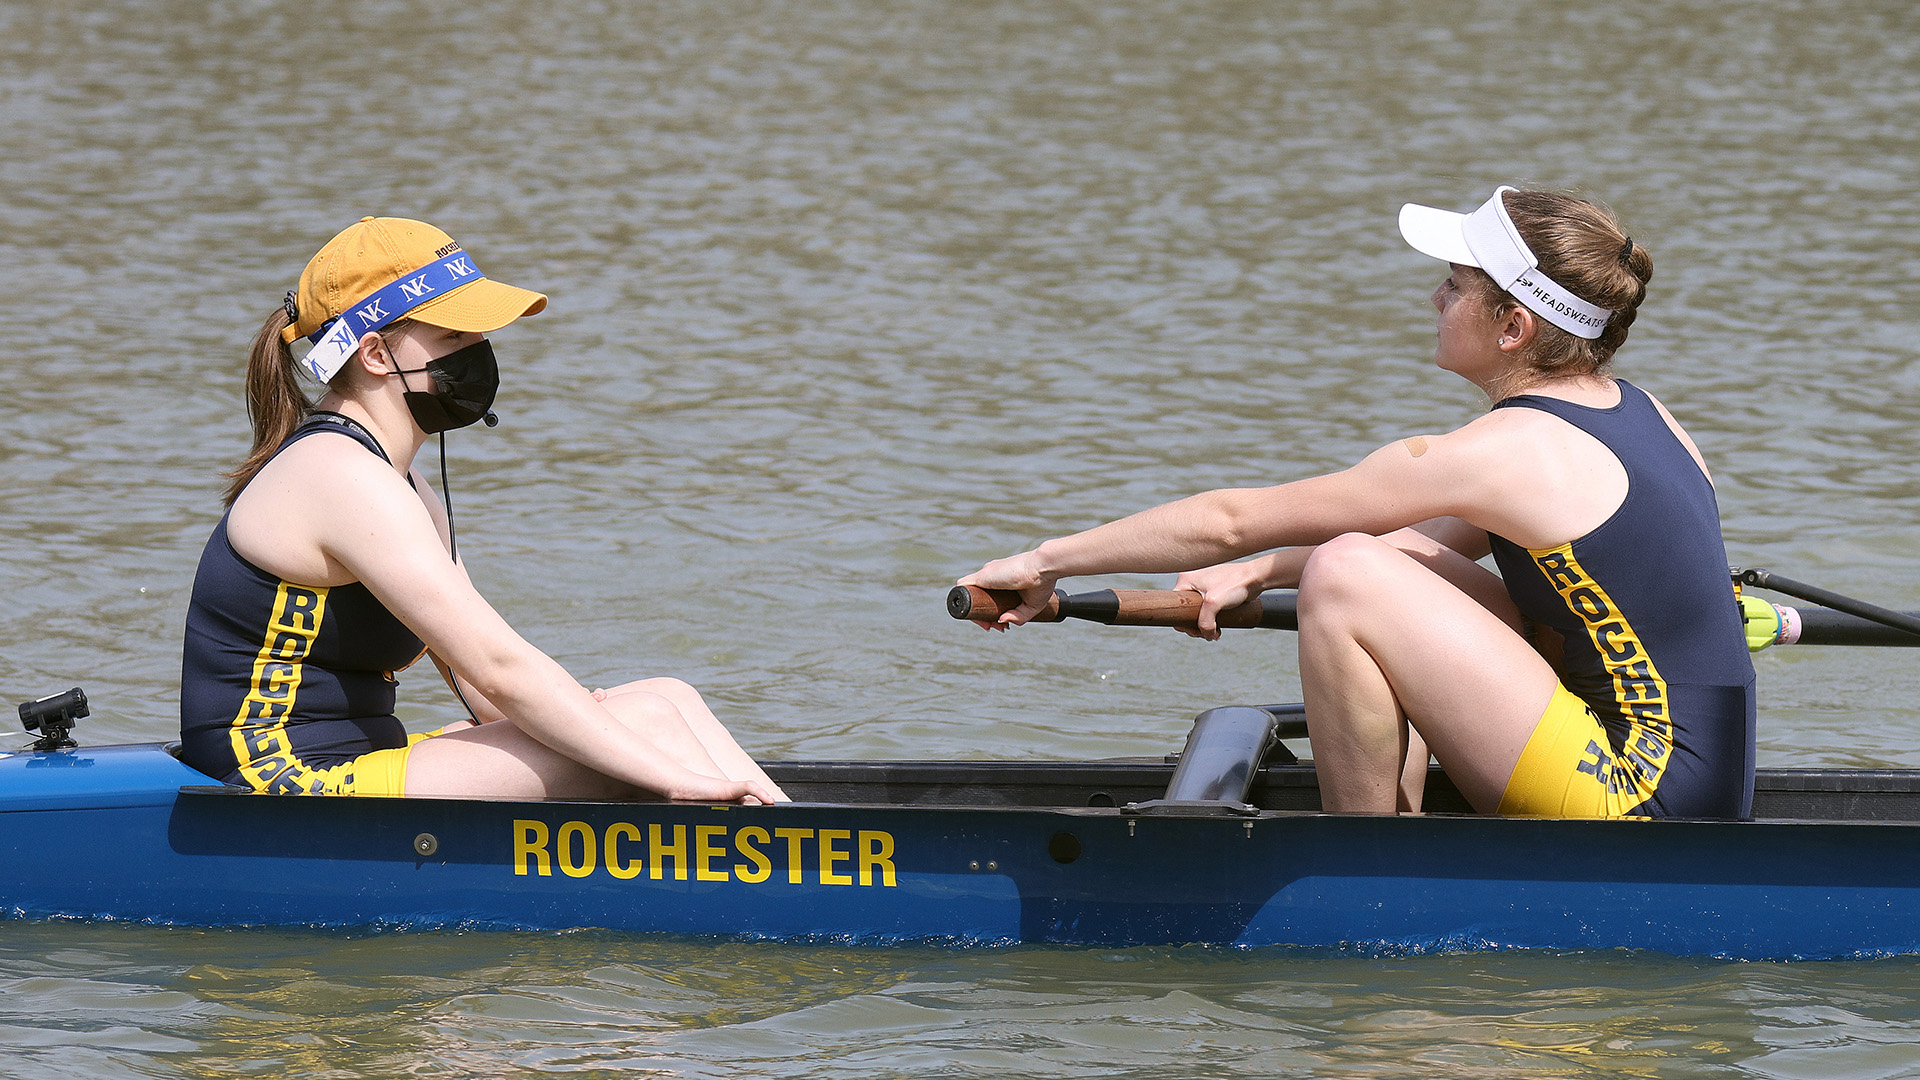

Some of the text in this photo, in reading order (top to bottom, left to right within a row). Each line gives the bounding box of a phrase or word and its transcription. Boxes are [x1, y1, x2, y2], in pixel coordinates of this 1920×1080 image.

[355, 256, 476, 330] NK NK NK
[513, 819, 897, 887] ROCHESTER
